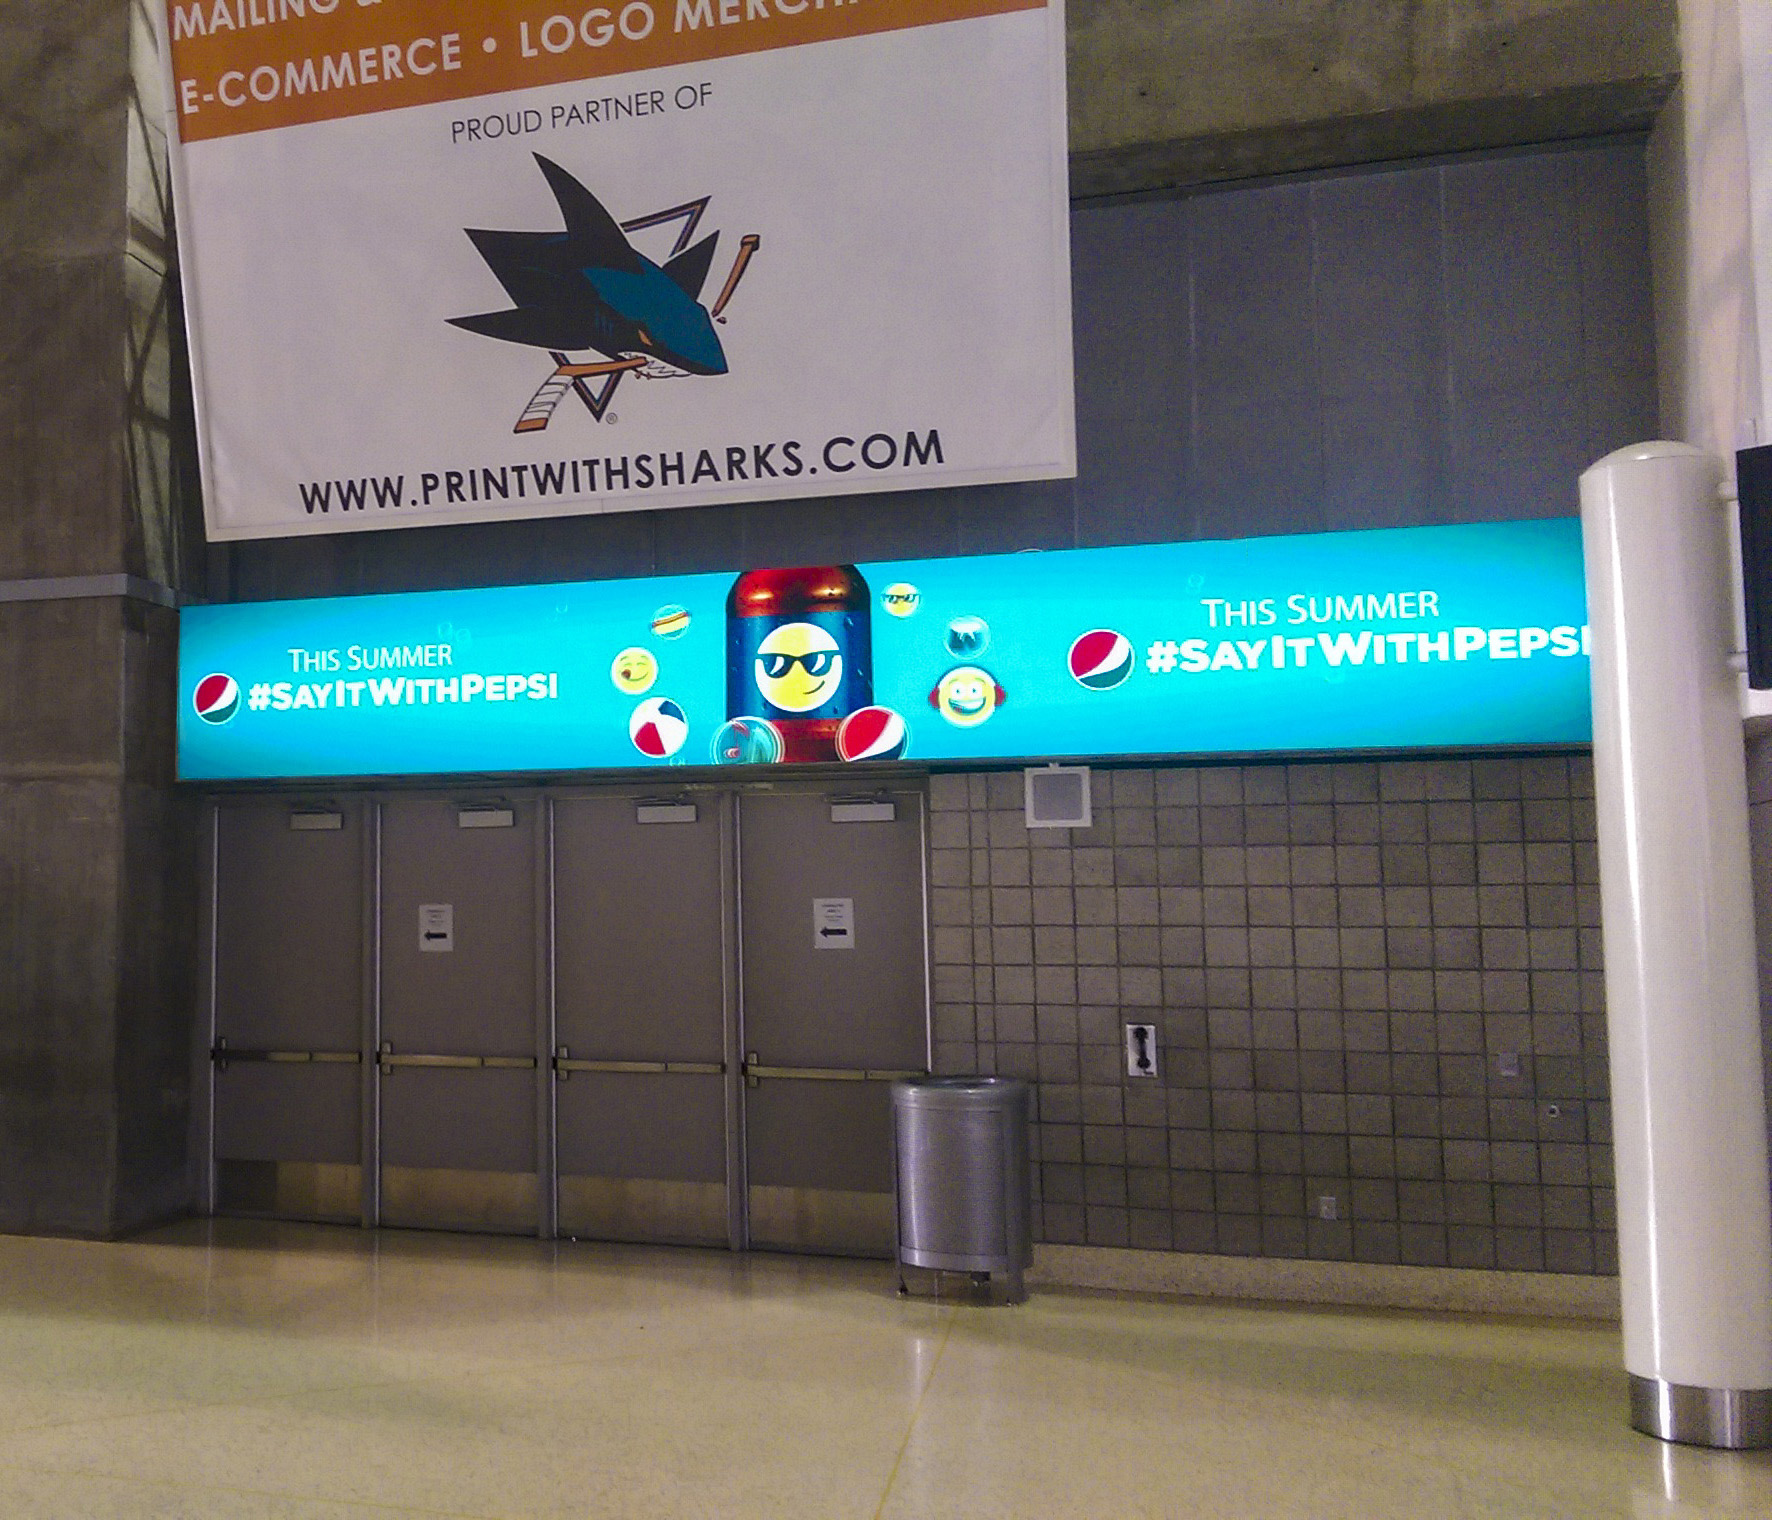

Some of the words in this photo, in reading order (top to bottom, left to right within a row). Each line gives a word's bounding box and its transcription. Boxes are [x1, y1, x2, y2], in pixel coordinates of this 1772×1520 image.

[180, 33, 463, 115] E-COMMERCE
[519, 1, 655, 58] LOGO
[674, 0, 858, 33] MER
[451, 110, 542, 144] PROUD
[551, 90, 665, 129] PARTNER
[675, 82, 713, 110] OF
[299, 428, 945, 514] WWW.PRINTWITHSHARKS.COM
